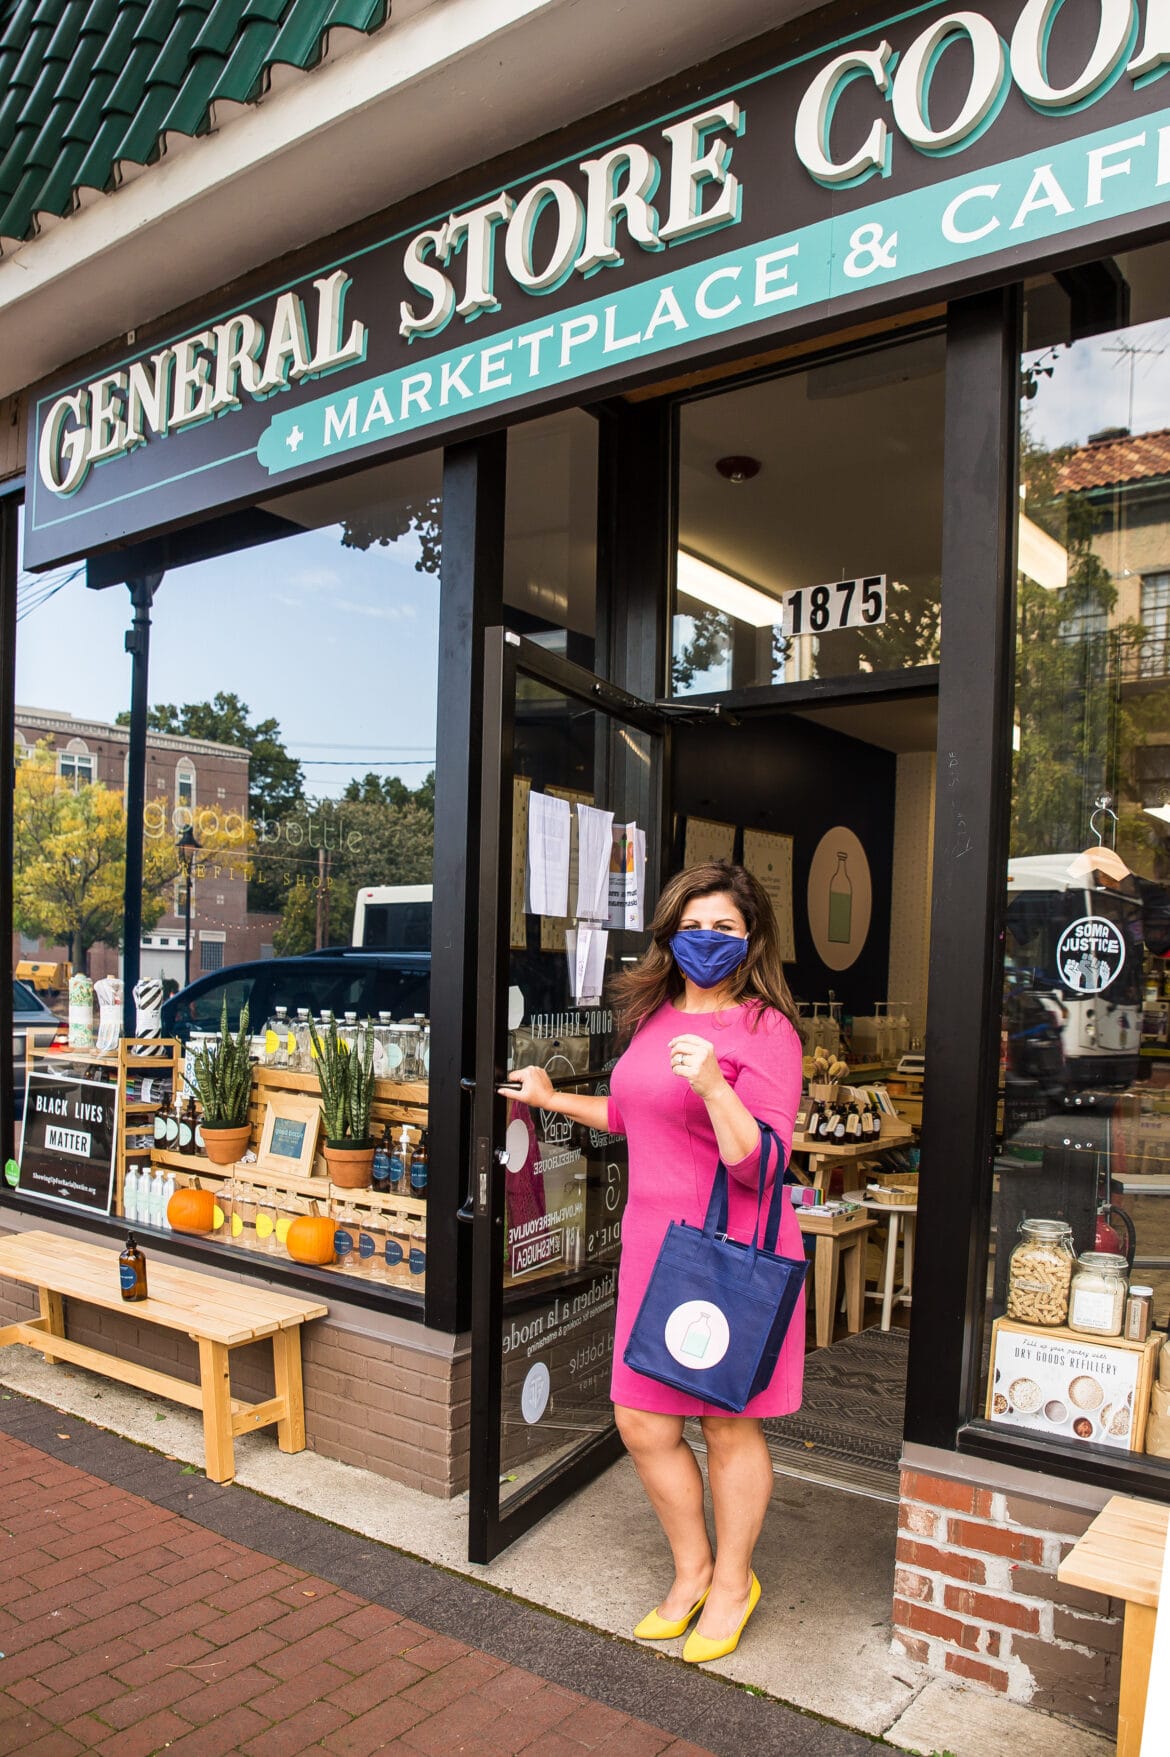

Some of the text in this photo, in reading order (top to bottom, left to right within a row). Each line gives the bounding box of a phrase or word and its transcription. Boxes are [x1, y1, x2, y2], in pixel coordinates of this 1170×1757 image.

[39, 0, 1170, 496] GENERAL STORE COO
[322, 128, 1170, 446] MARKETPLACE & CAF
[788, 576, 882, 634] 1875
[143, 803, 363, 853] good bottle
[181, 862, 334, 888] REFILL SHOP
[1062, 924, 1119, 953] SOMA JUSTICE
[36, 1095, 103, 1123] BLACK LIVES
[49, 1130, 88, 1153] MATTER
[1015, 1346, 1118, 1376] DRY GOODS REFILLERY
